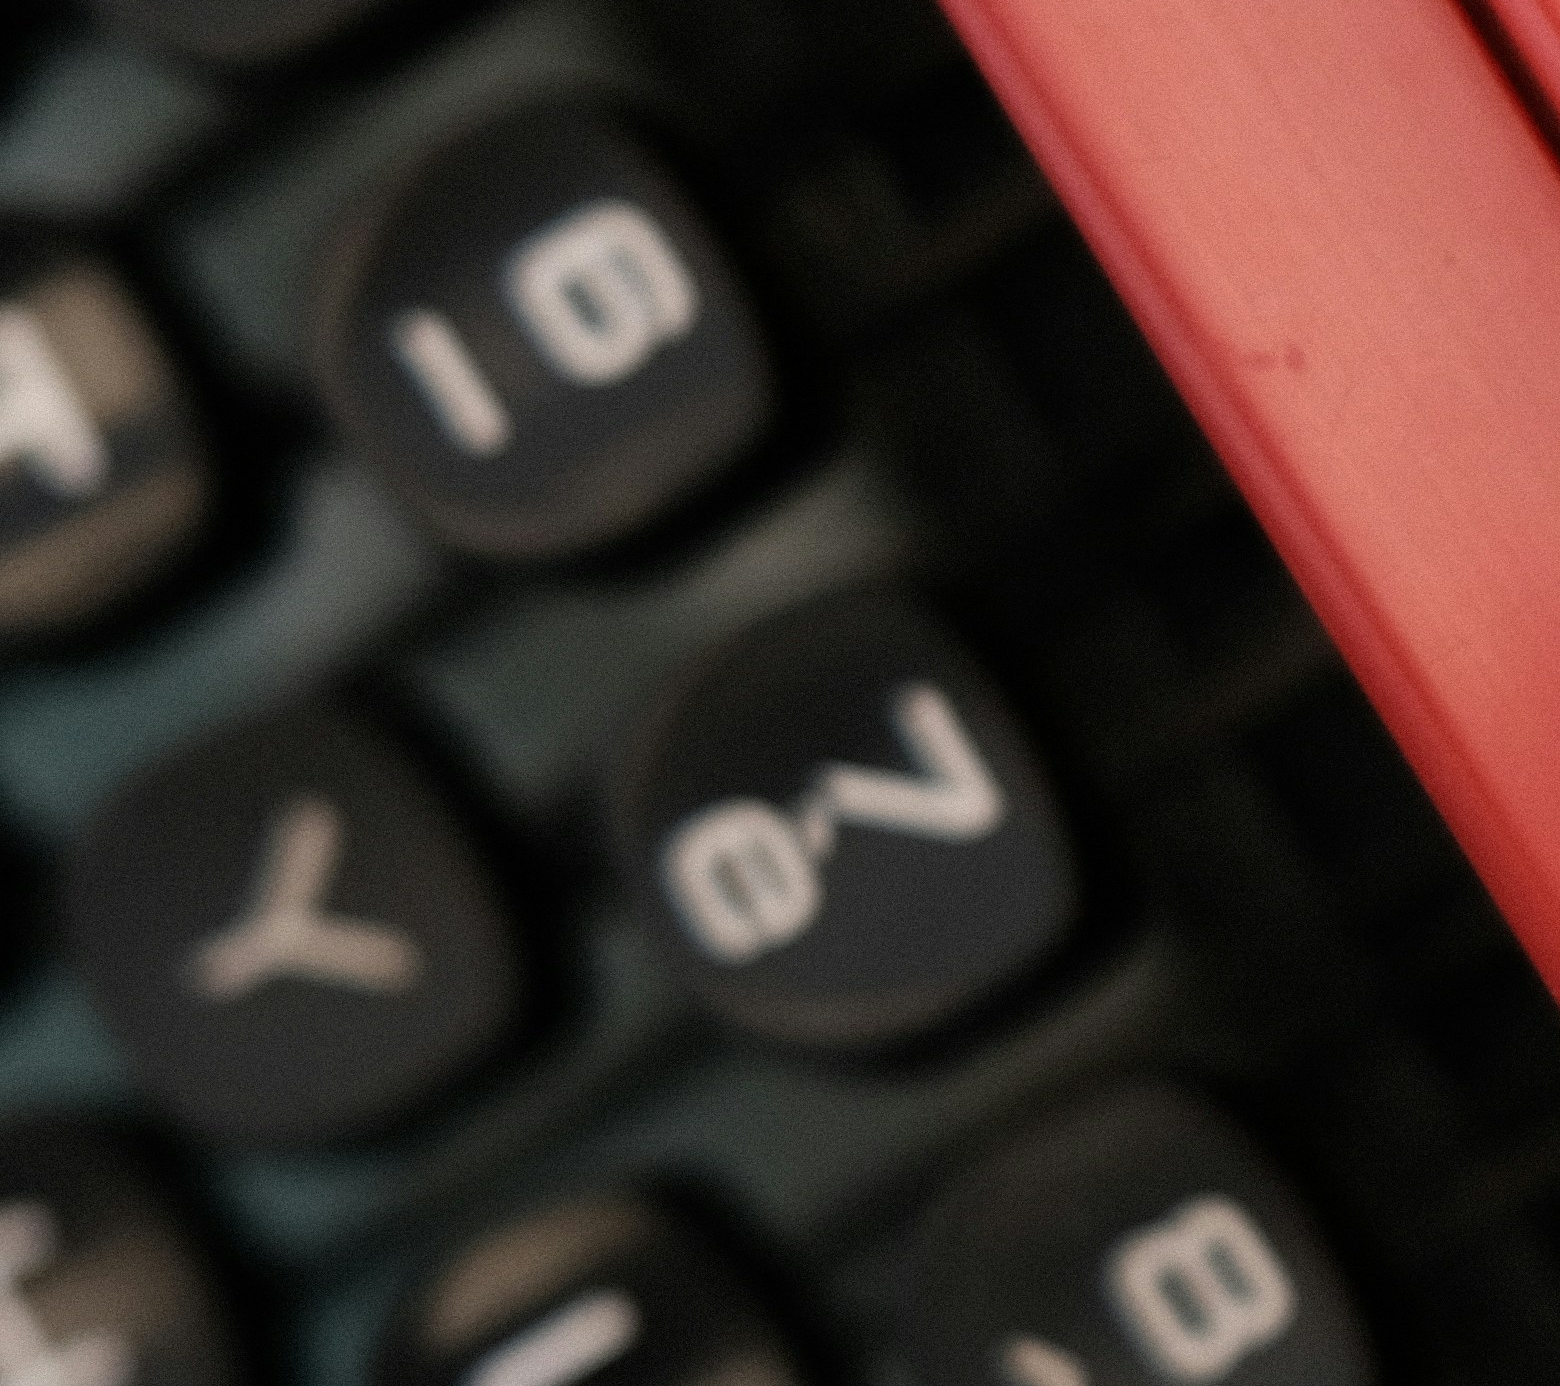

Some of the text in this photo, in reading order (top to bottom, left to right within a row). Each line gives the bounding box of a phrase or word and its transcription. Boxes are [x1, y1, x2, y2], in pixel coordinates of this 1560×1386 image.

[506, 203, 696, 385] 6
[826, 689, 1004, 838] 7
[194, 808, 413, 999] Y
[1110, 1198, 1294, 1386] 8
